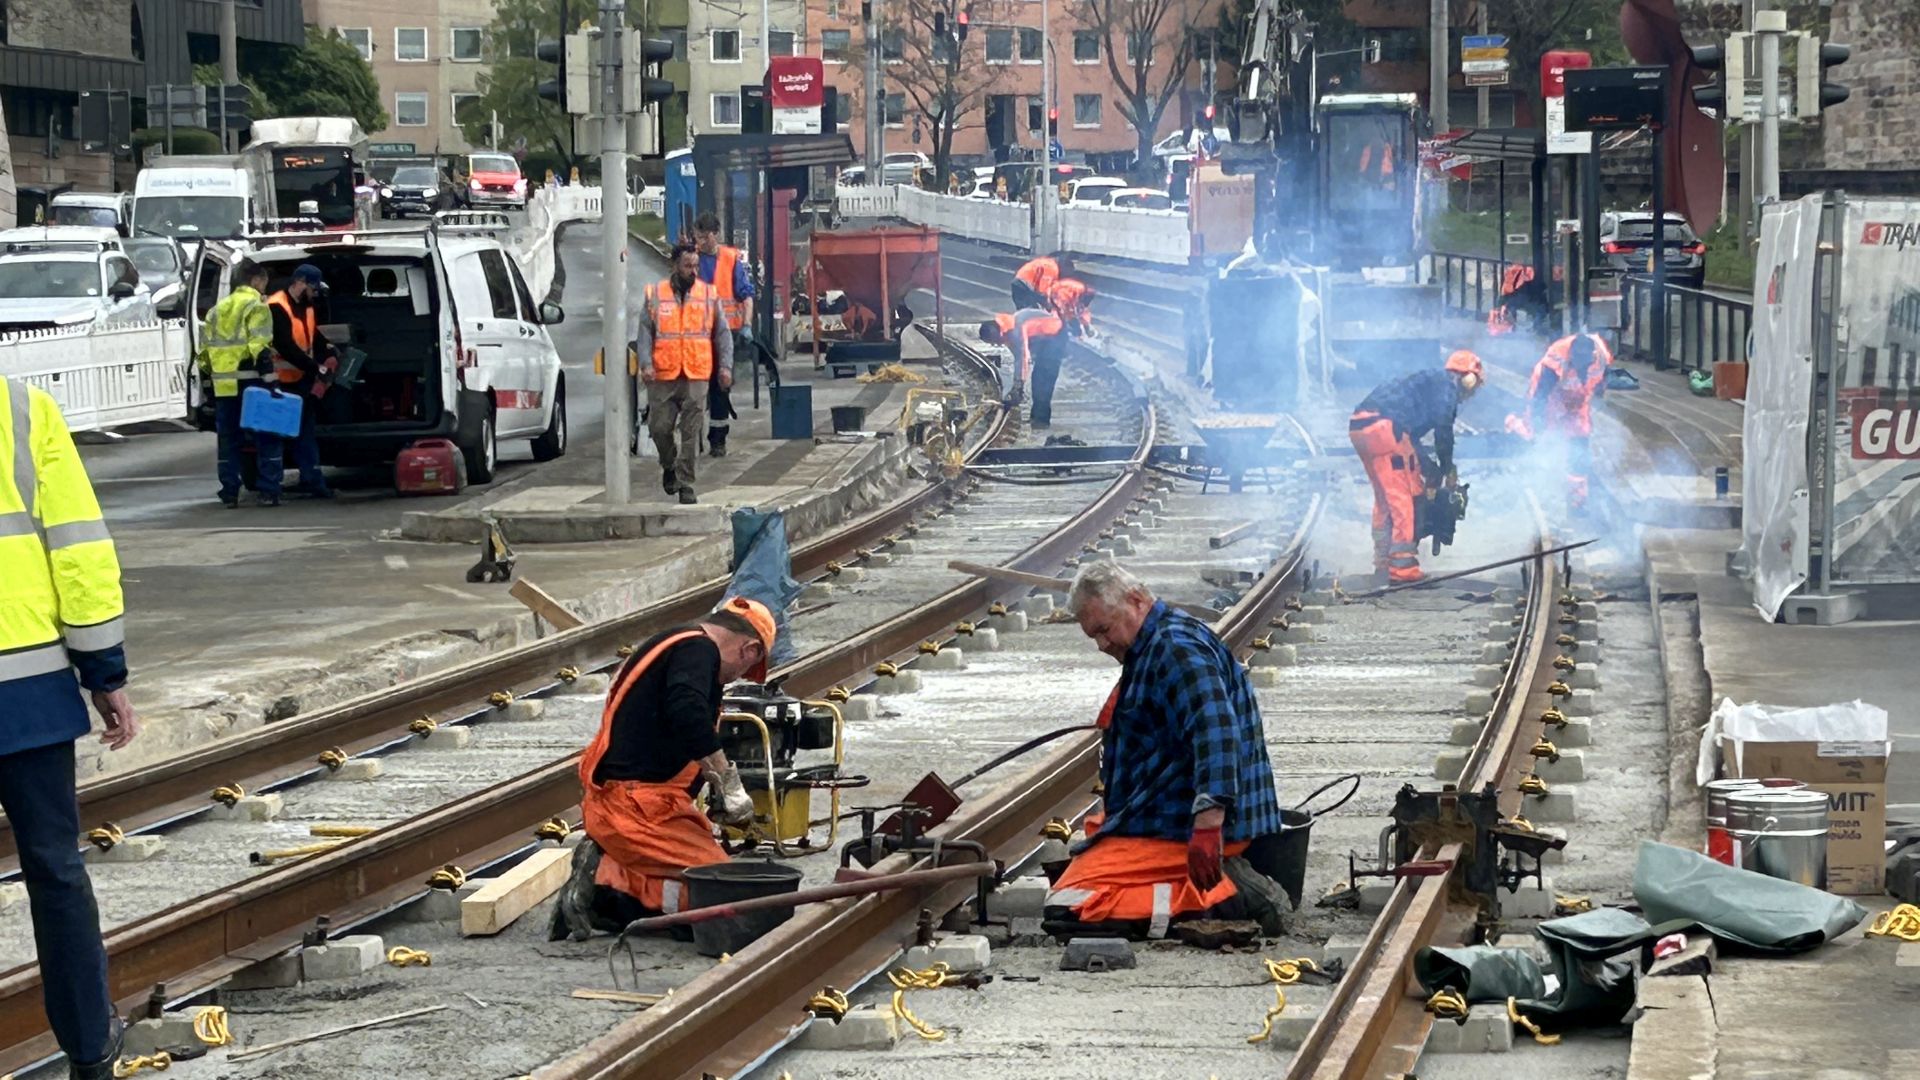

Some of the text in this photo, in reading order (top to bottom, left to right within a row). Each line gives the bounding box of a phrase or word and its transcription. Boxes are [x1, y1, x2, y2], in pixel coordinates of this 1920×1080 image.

[1881, 223, 1920, 251] TRA
[1861, 408, 1920, 455] GU
[1828, 792, 1870, 812] MIT
